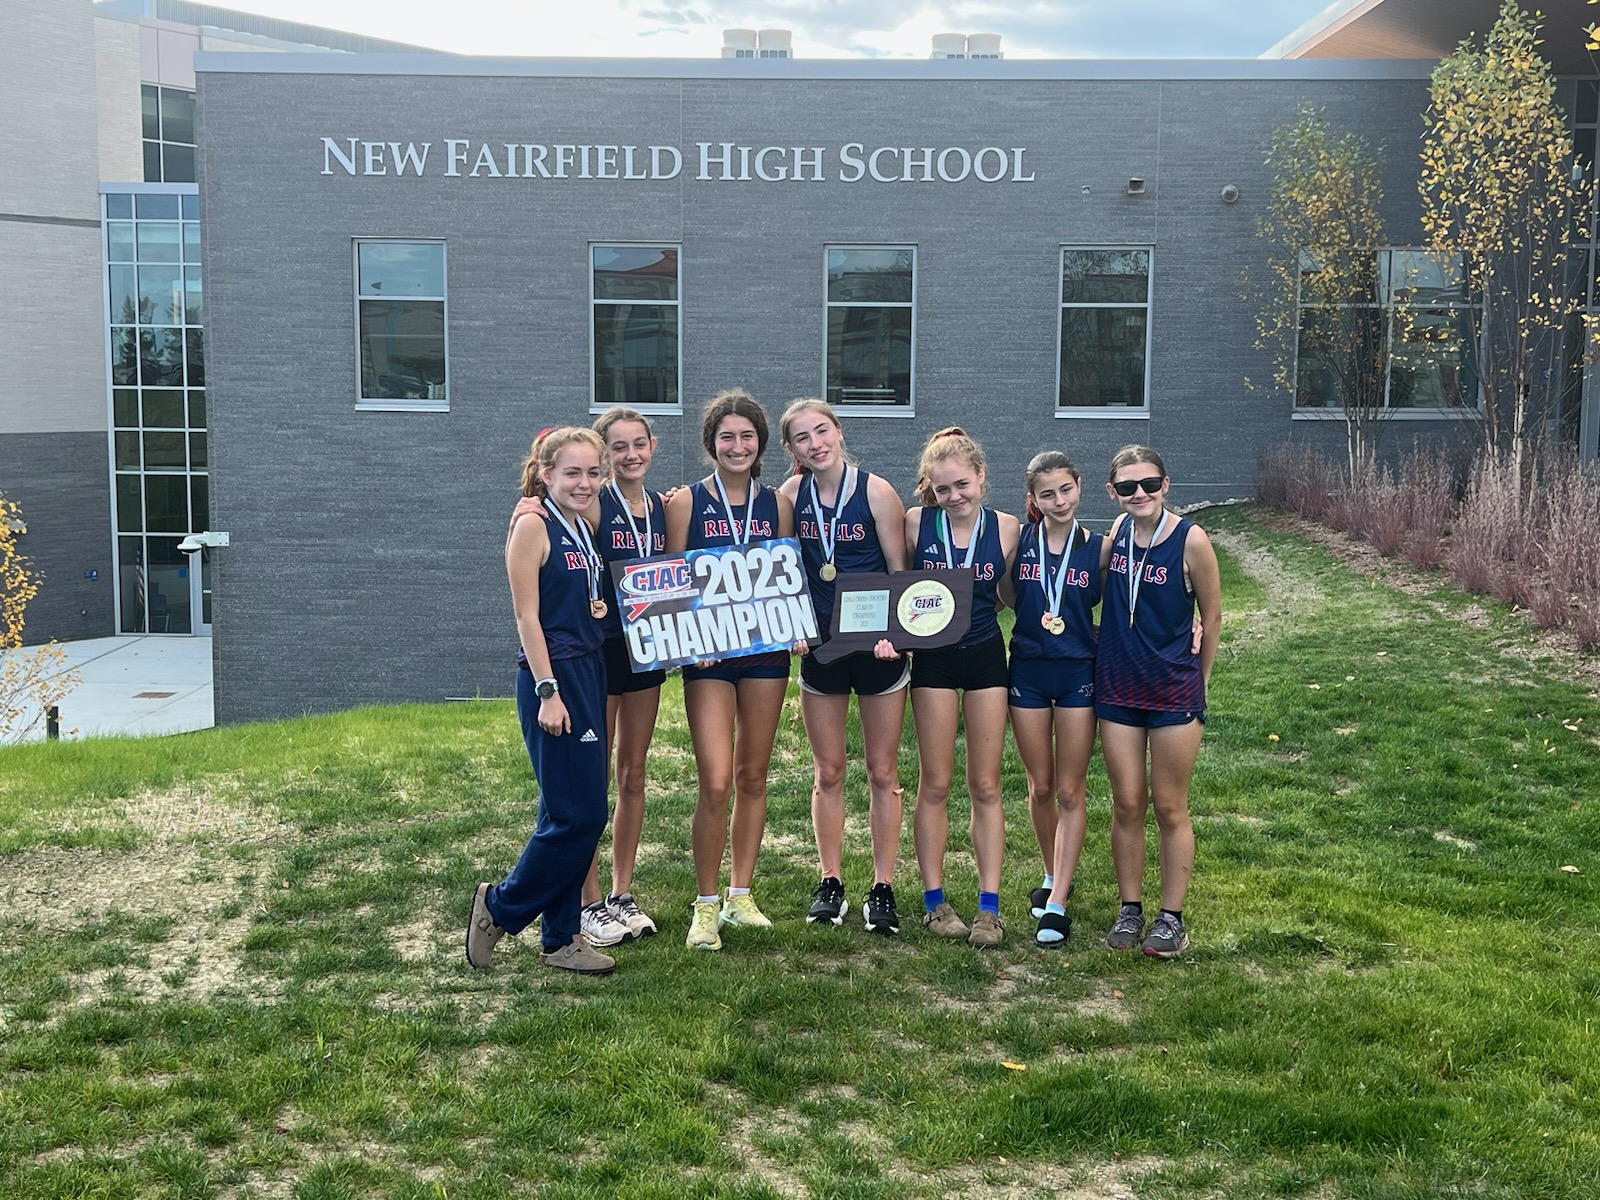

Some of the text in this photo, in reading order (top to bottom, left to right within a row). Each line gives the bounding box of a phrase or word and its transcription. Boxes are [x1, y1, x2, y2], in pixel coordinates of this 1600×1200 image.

[320, 137, 1036, 183] NEW FAIRFIELD HIGH SCHOOL
[704, 519, 771, 537] REBLS
[632, 564, 692, 592] CIAC
[695, 545, 803, 606] 2023
[1019, 563, 1089, 588] RELS
[1109, 552, 1168, 585] REBLS
[915, 597, 943, 608] CIAC
[628, 594, 818, 665] CHAMPION
